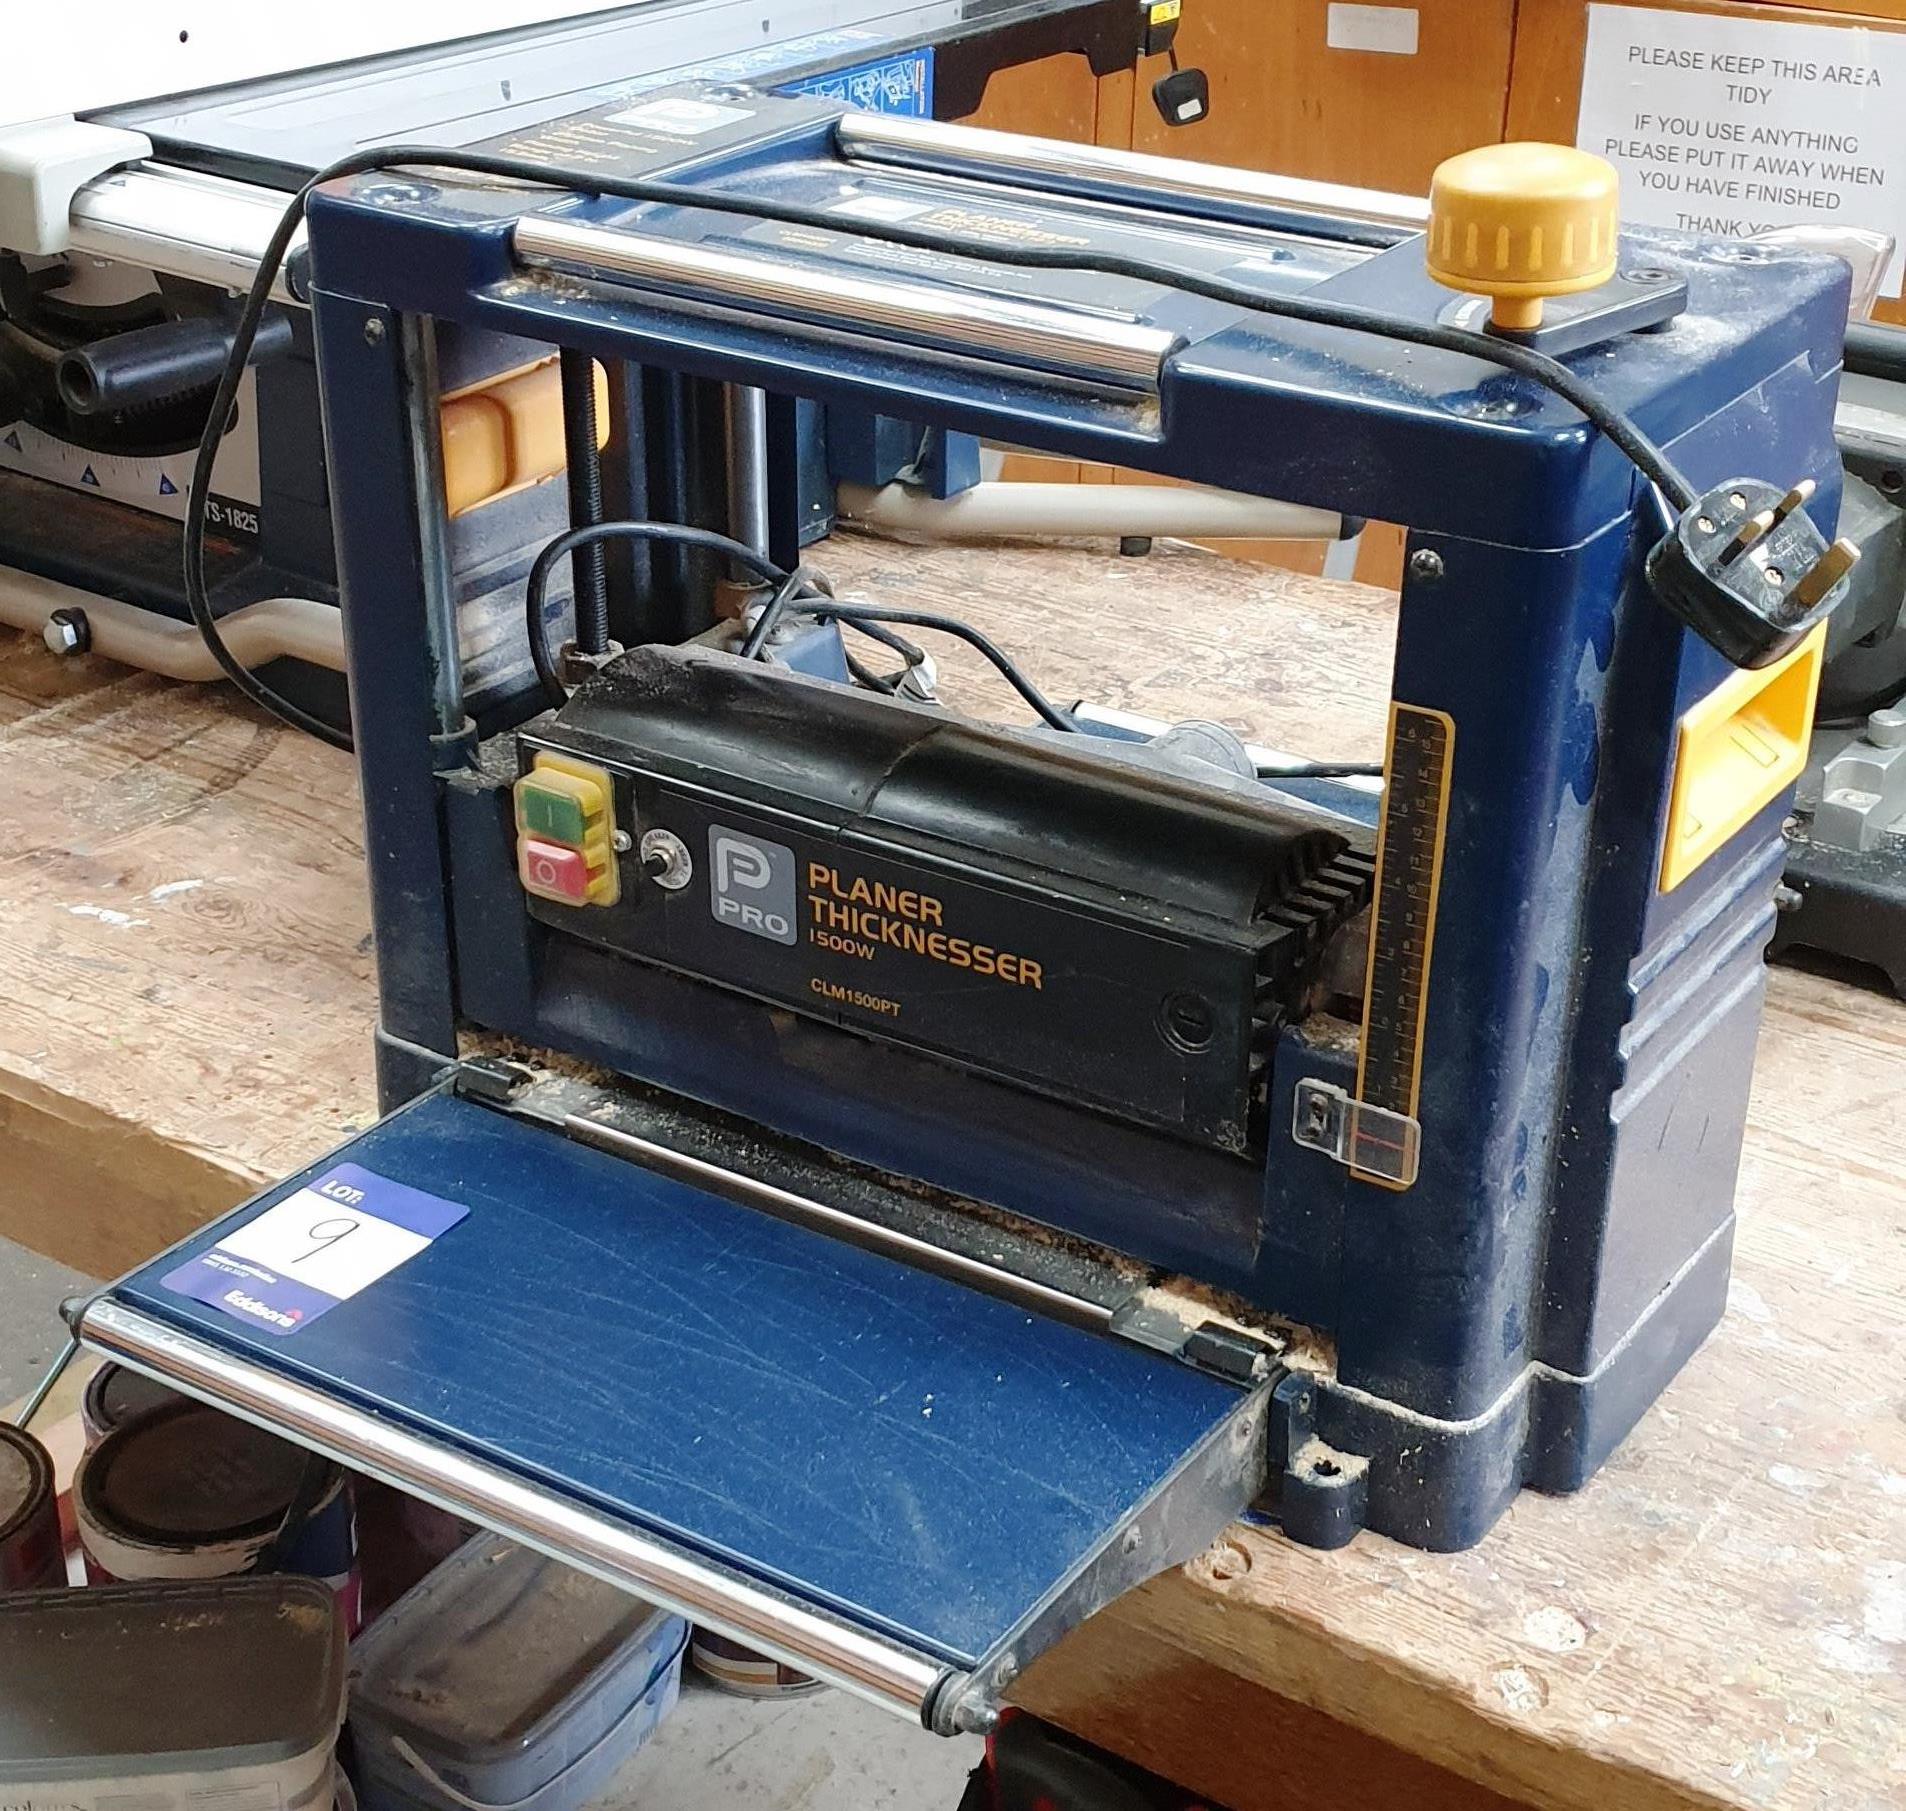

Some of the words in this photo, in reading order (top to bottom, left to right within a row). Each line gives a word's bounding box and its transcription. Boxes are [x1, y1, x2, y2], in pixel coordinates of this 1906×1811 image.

[1628, 46, 1704, 70] PLEASE
[1711, 54, 1765, 75] KEEP
[1771, 60, 1817, 81] THIS
[1822, 65, 1881, 87] AREA
[1727, 84, 1772, 105] TIDY
[1634, 114, 1651, 131] IF
[1658, 116, 1700, 137] YOU
[1706, 123, 1746, 142] USE
[1750, 127, 1859, 154] ANYTHING
[1605, 139, 1680, 164] PLEASE
[1686, 149, 1726, 167] PUT
[1731, 153, 1749, 170] IT
[1753, 156, 1815, 180] AWAY
[1820, 164, 1885, 187] WHEN
[1639, 170, 1680, 192] YOU
[1685, 177, 1739, 199] HAVE
[1745, 183, 1841, 210] FINISHED
[1676, 212, 1743, 238] THANK
[809, 862, 944, 927] PLANER
[719, 896, 788, 935] PRO
[808, 895, 1044, 991] THICKNESSER
[809, 928, 876, 961] 1500W
[811, 978, 902, 1017] CLM1500PT
[320, 1180, 366, 1205] LOT:
[291, 1218, 361, 1264] 9
